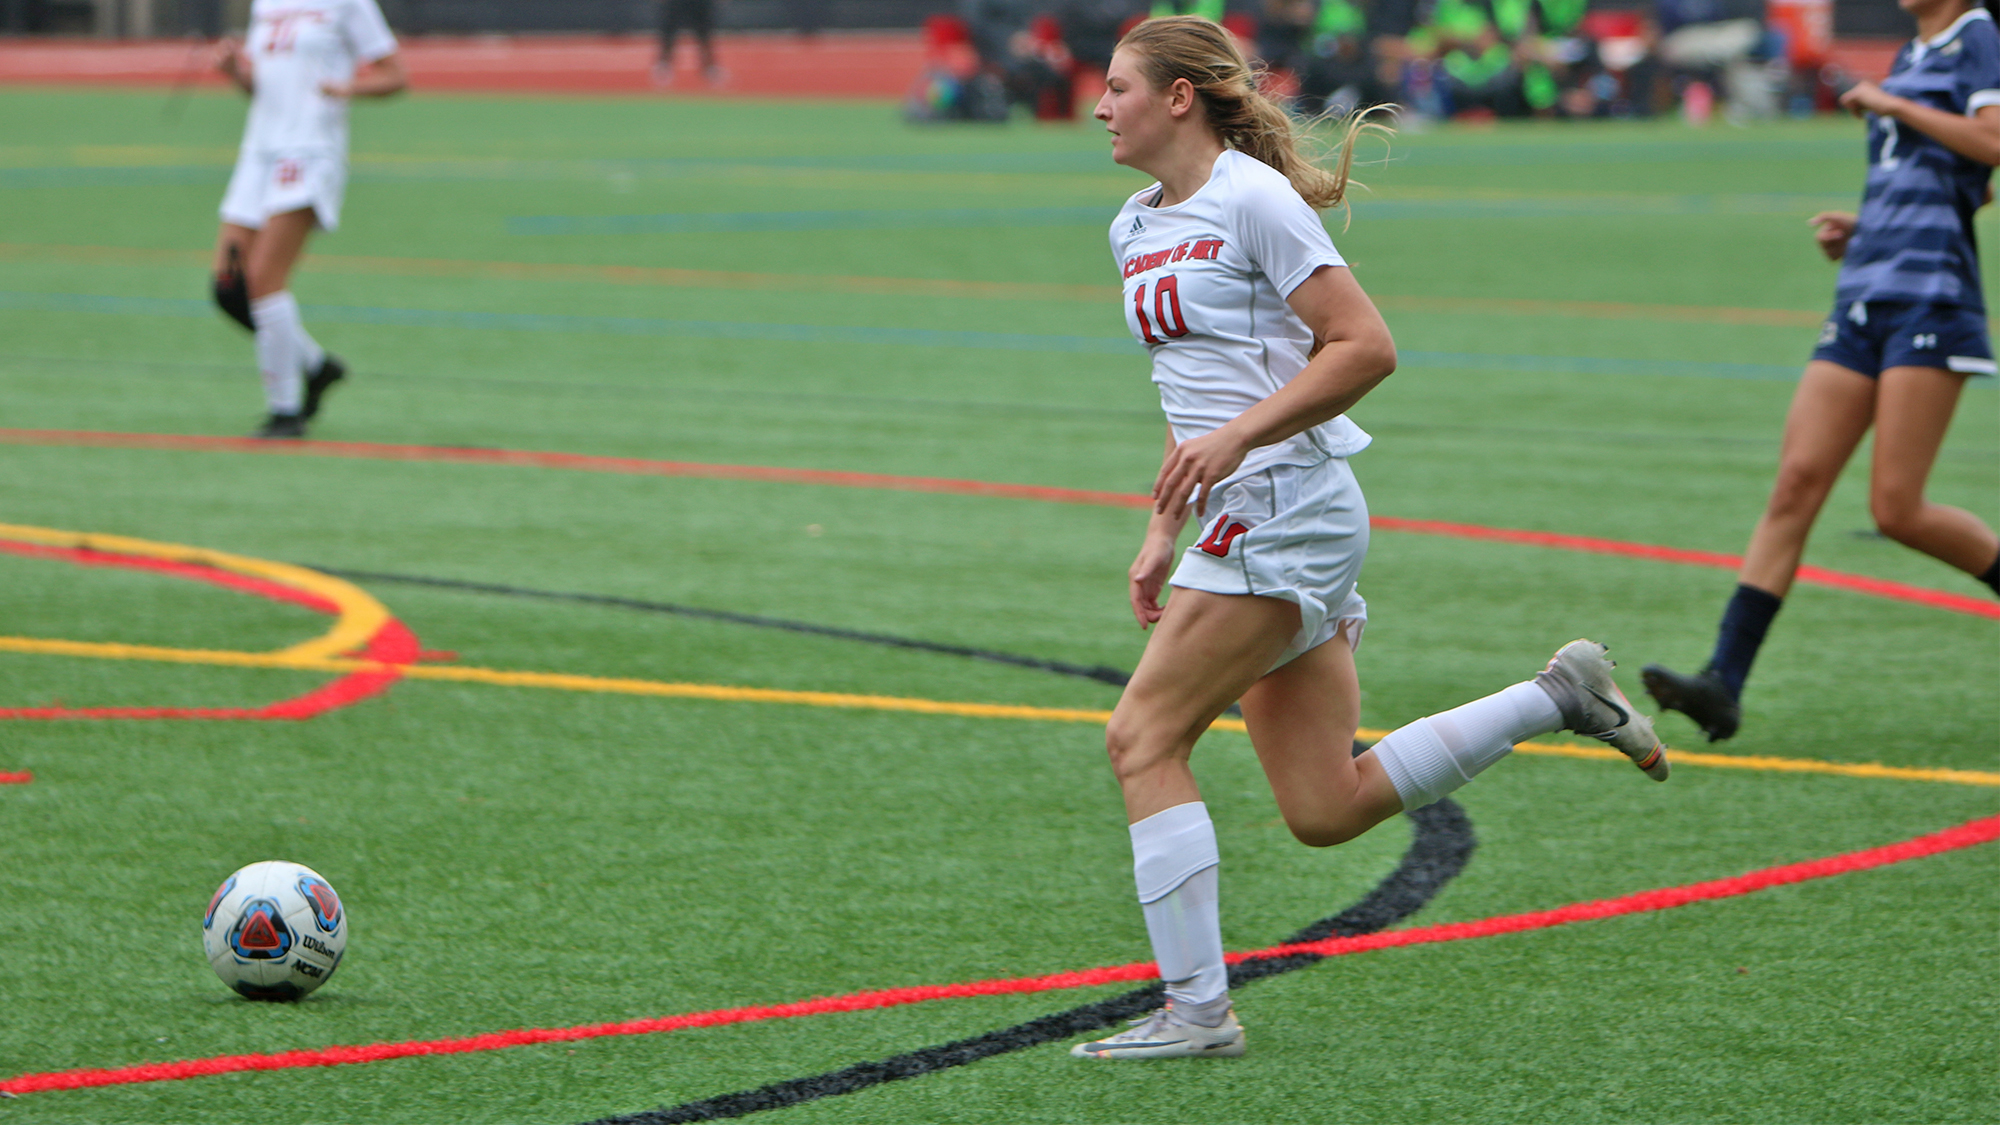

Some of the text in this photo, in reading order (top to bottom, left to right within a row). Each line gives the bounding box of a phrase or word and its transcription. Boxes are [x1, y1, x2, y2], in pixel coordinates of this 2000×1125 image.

[1171, 242, 1190, 263] OF
[1186, 239, 1225, 260] ART
[1134, 273, 1190, 343] 10
[303, 935, 335, 960] Wilson
